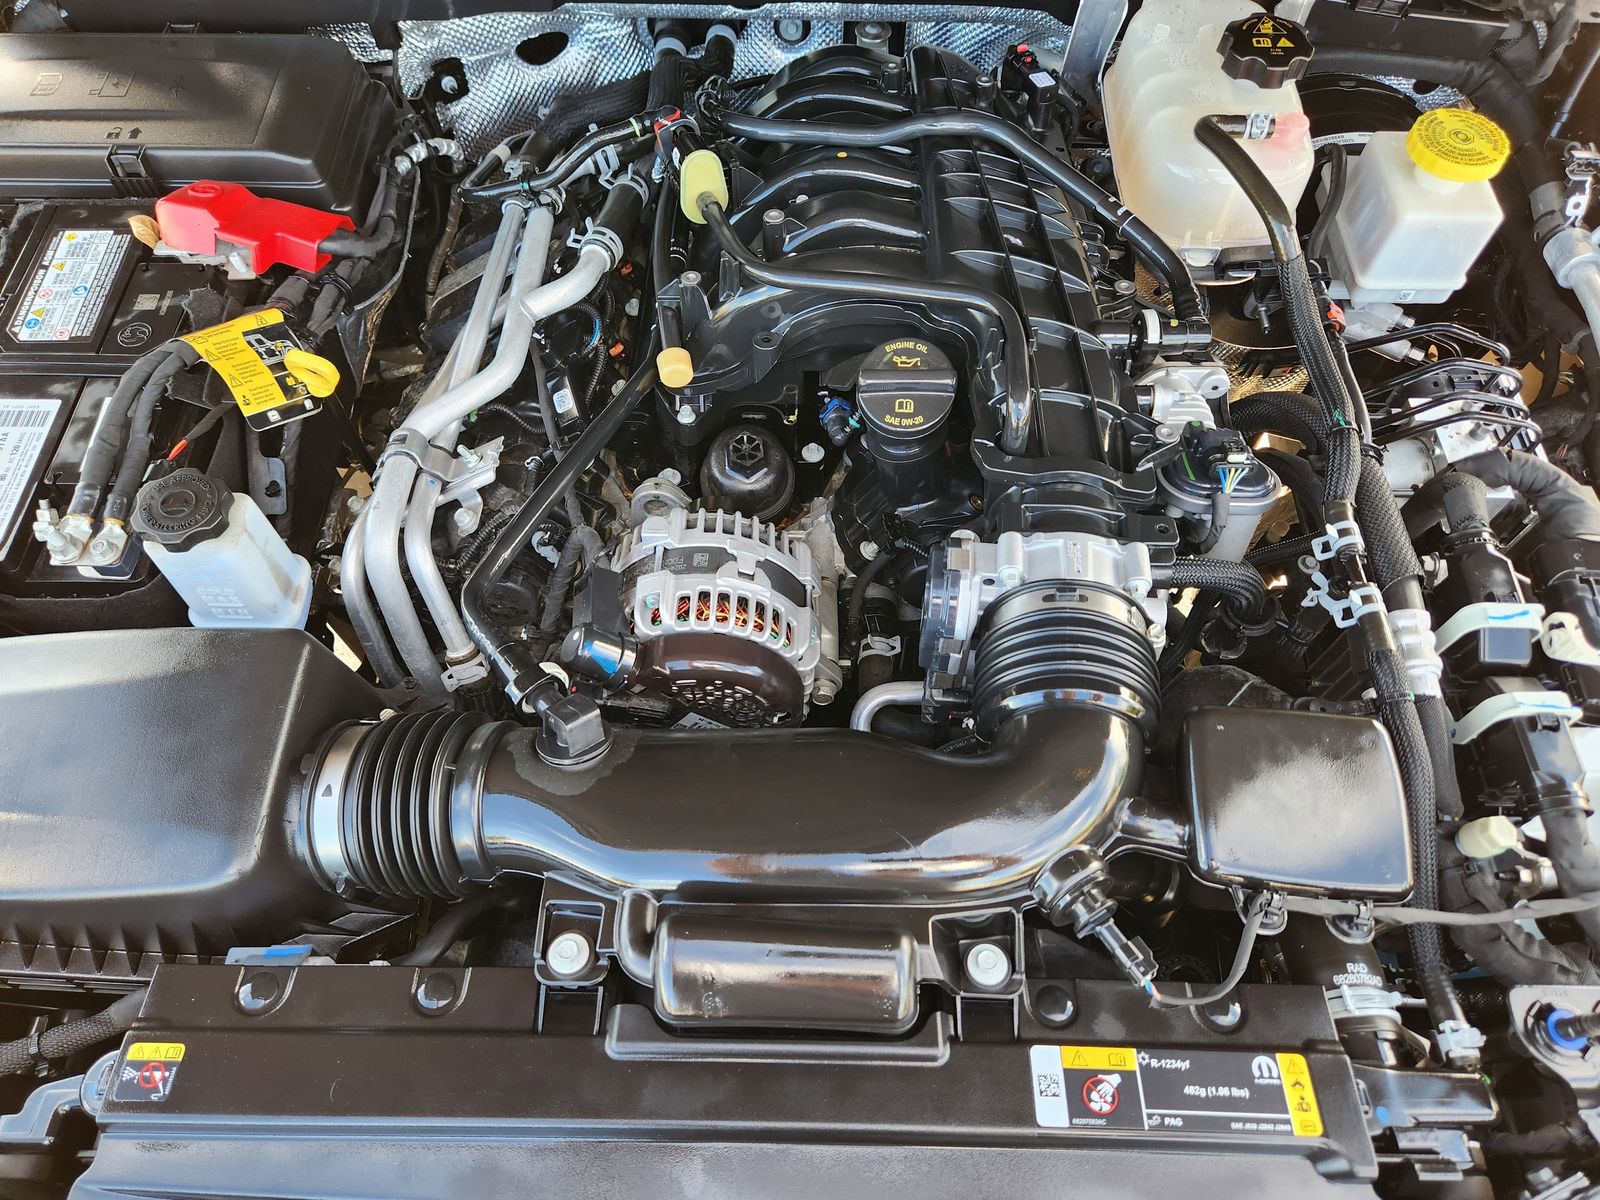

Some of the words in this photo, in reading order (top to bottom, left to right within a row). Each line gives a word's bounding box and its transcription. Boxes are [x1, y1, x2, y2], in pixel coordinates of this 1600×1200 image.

[884, 341, 915, 353] ENGINE
[916, 343, 928, 354] OIL
[884, 414, 900, 425] SAE
[901, 415, 924, 426] 0W-20
[169, 475, 211, 492] APPROVED
[1346, 962, 1369, 974] RAD
[1150, 1058, 1191, 1071] R-1234yf
[1183, 1085, 1206, 1097] 482g
[1207, 1086, 1230, 1098] (1.06
[1231, 1086, 1250, 1099] lbs)
[1164, 1116, 1183, 1127] PAG
